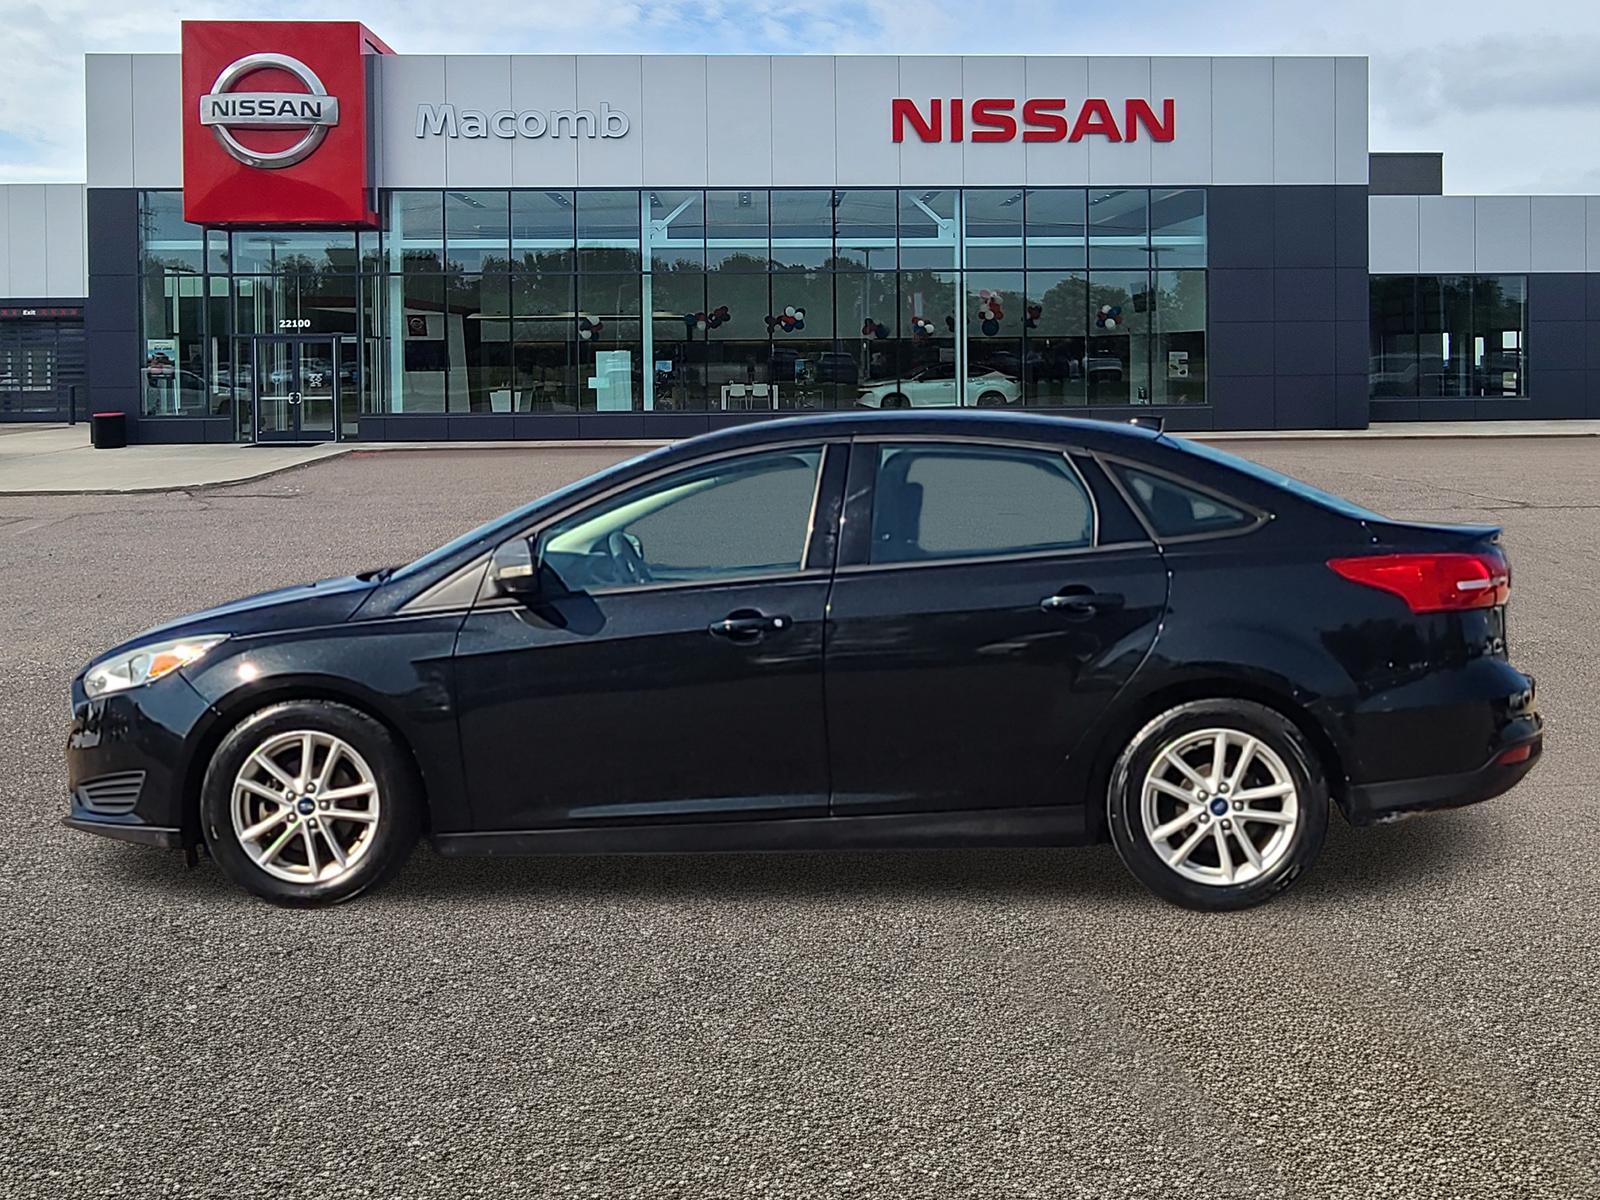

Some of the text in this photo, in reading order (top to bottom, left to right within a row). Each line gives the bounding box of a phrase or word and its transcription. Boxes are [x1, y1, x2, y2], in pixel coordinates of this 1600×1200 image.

[211, 100, 322, 118] NISSAN
[415, 102, 630, 139] Macomb
[892, 98, 1175, 143] NISSAN
[279, 319, 311, 328] 22100
